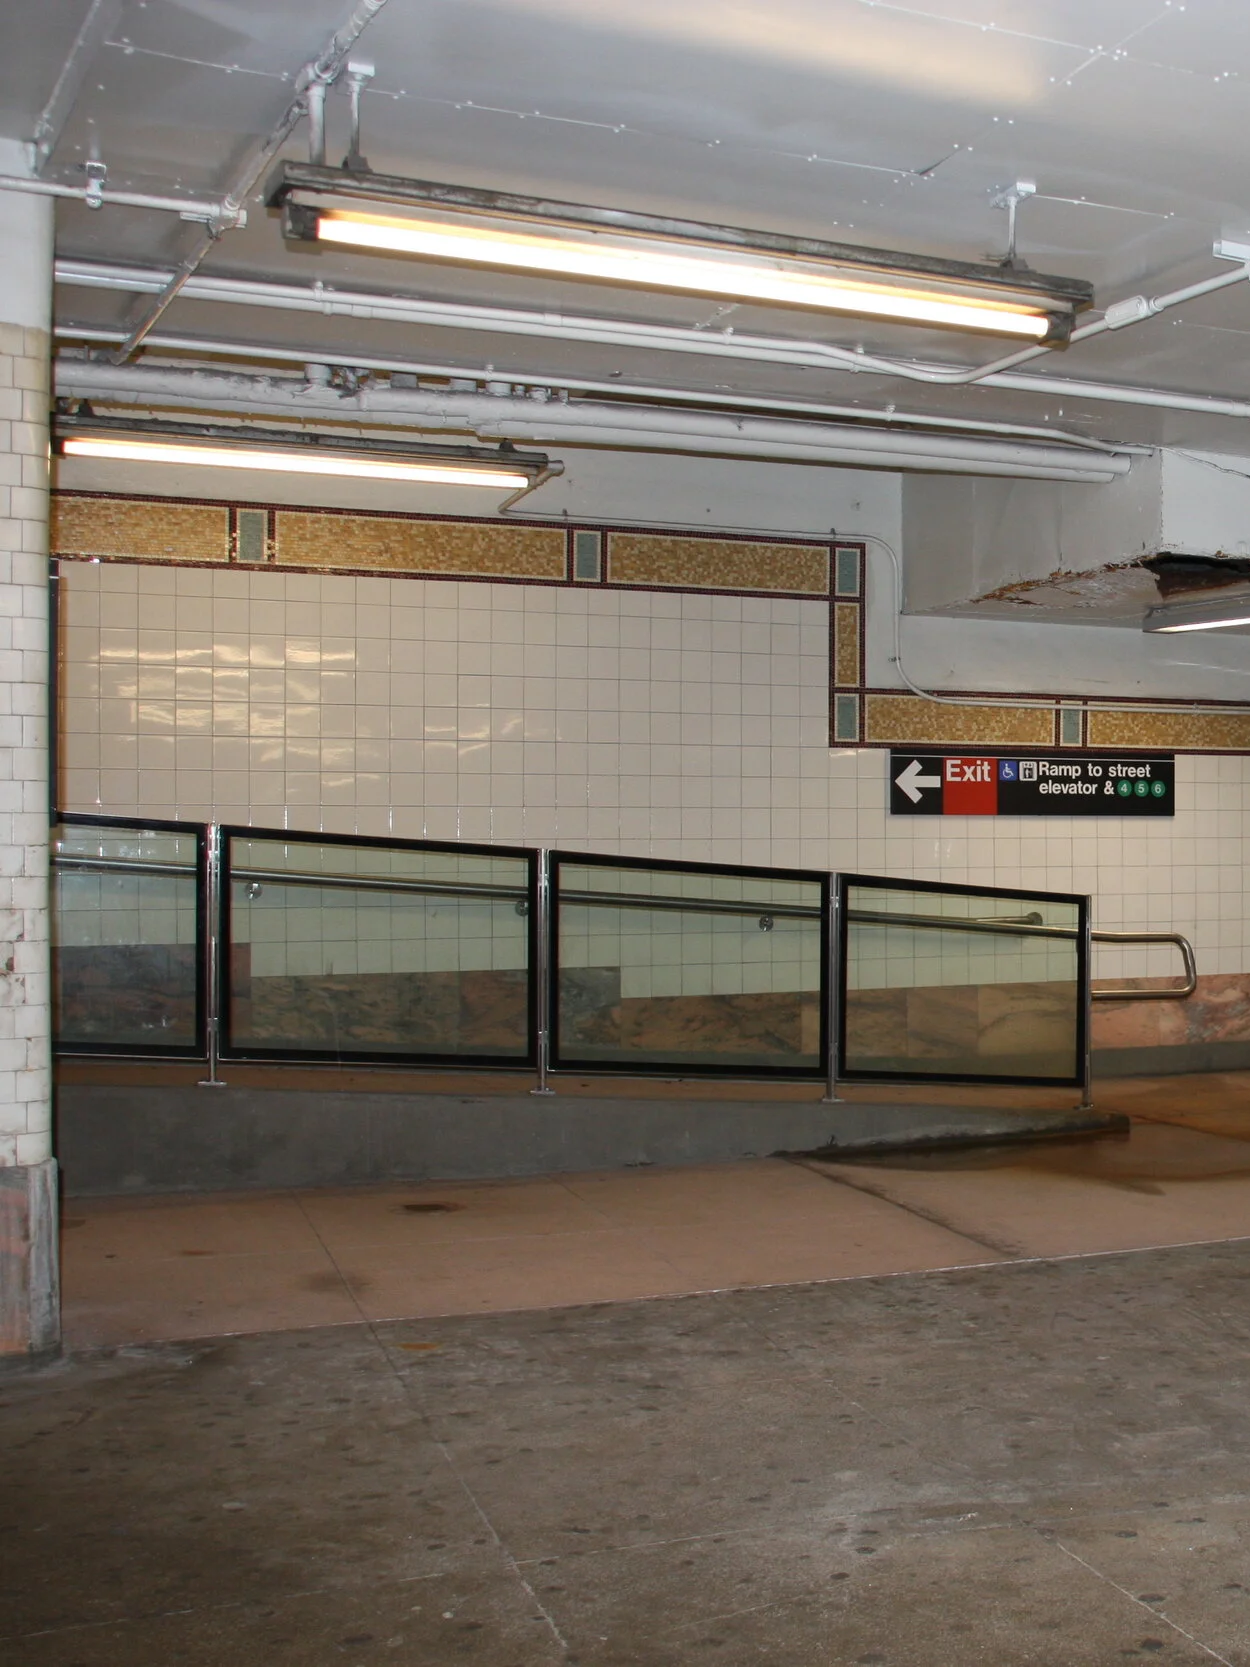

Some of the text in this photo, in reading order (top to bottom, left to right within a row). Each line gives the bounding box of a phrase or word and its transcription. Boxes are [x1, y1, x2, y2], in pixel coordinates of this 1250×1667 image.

[946, 760, 991, 782] Exit
[1039, 761, 1151, 779] Ramp to street
[1039, 780, 1162, 795] elevator & 4 5 6
